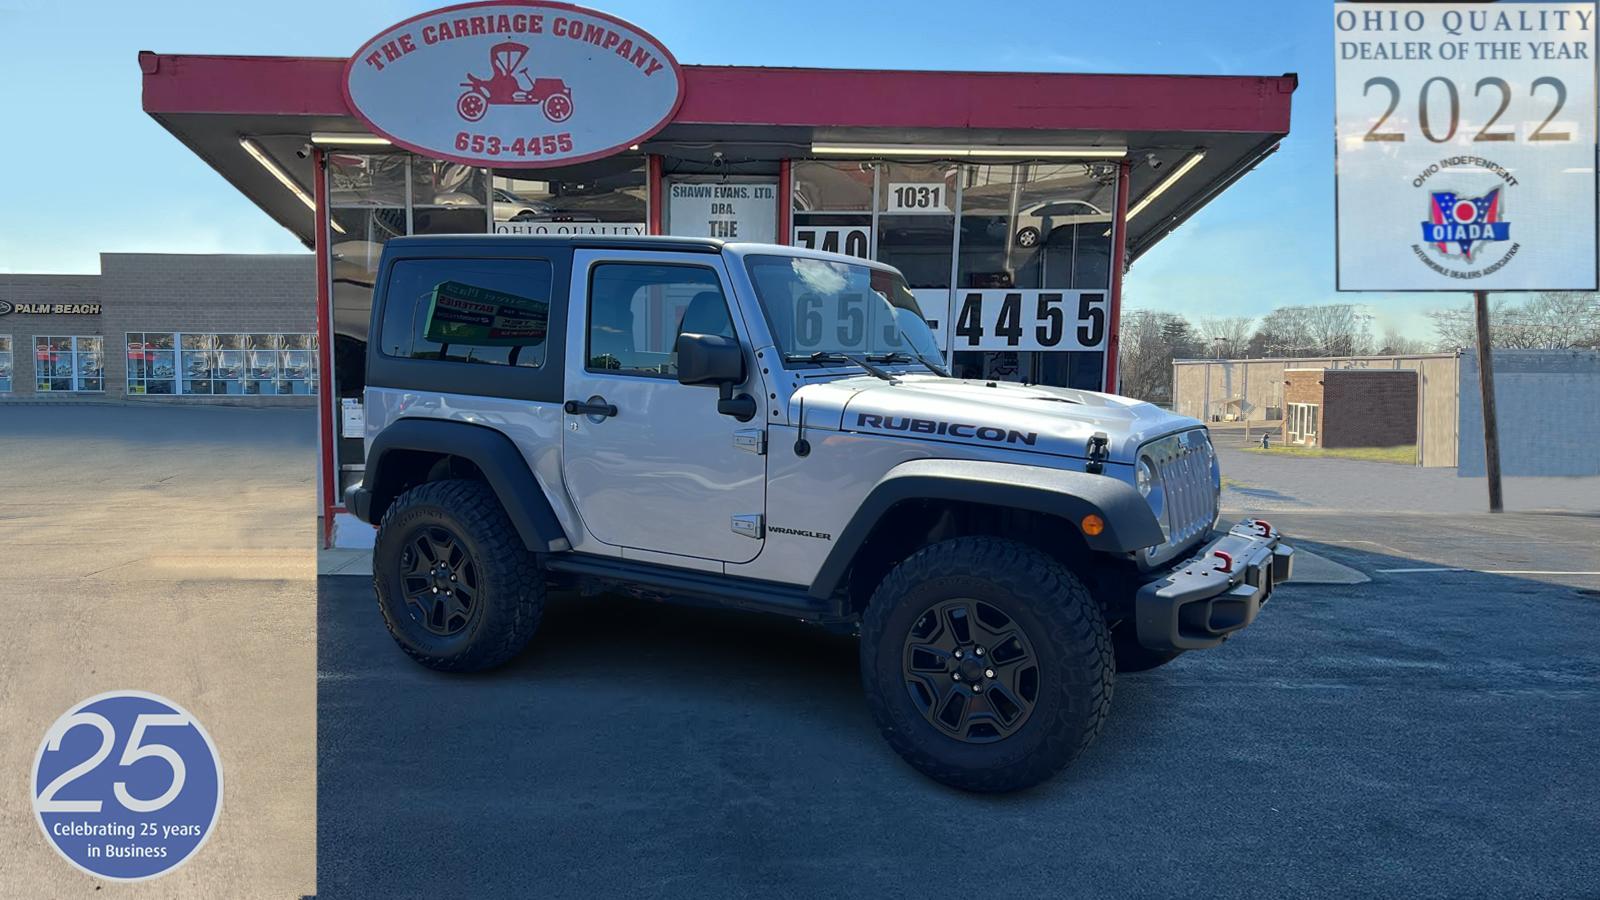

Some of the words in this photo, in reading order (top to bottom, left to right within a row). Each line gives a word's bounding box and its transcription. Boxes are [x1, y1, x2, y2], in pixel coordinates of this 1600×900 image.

[1336, 10, 1425, 31] OHIO
[1442, 10, 1592, 36] QUALITY
[365, 34, 417, 71] THE
[422, 14, 543, 45] CARRIAGE
[552, 17, 664, 77] COMPANY
[1340, 41, 1433, 60] DEALER
[1438, 41, 1469, 60] OF
[1474, 41, 1521, 60] THE
[1528, 41, 1589, 60] YEAR
[1362, 76, 1570, 143] 2022
[455, 132, 573, 156] 653-4455
[1412, 163, 1439, 188] OHIO
[1440, 155, 1519, 187] INDEPENDENT
[673, 186, 711, 198] SHAWN
[754, 187, 774, 199] LTD.
[894, 187, 940, 208] 1031
[711, 203, 735, 215] DBA.
[708, 221, 738, 237] THE
[1432, 224, 1495, 240] OIADA
[1411, 243, 1449, 277] AUTOMOBILE
[1449, 270, 1482, 279] DEALERS
[1482, 242, 1521, 276] ASSOCIATION
[15, 303, 51, 314] PALM
[54, 304, 101, 314] BEACH
[857, 412, 1038, 446] RUBICON
[768, 525, 831, 541] WRANGLER
